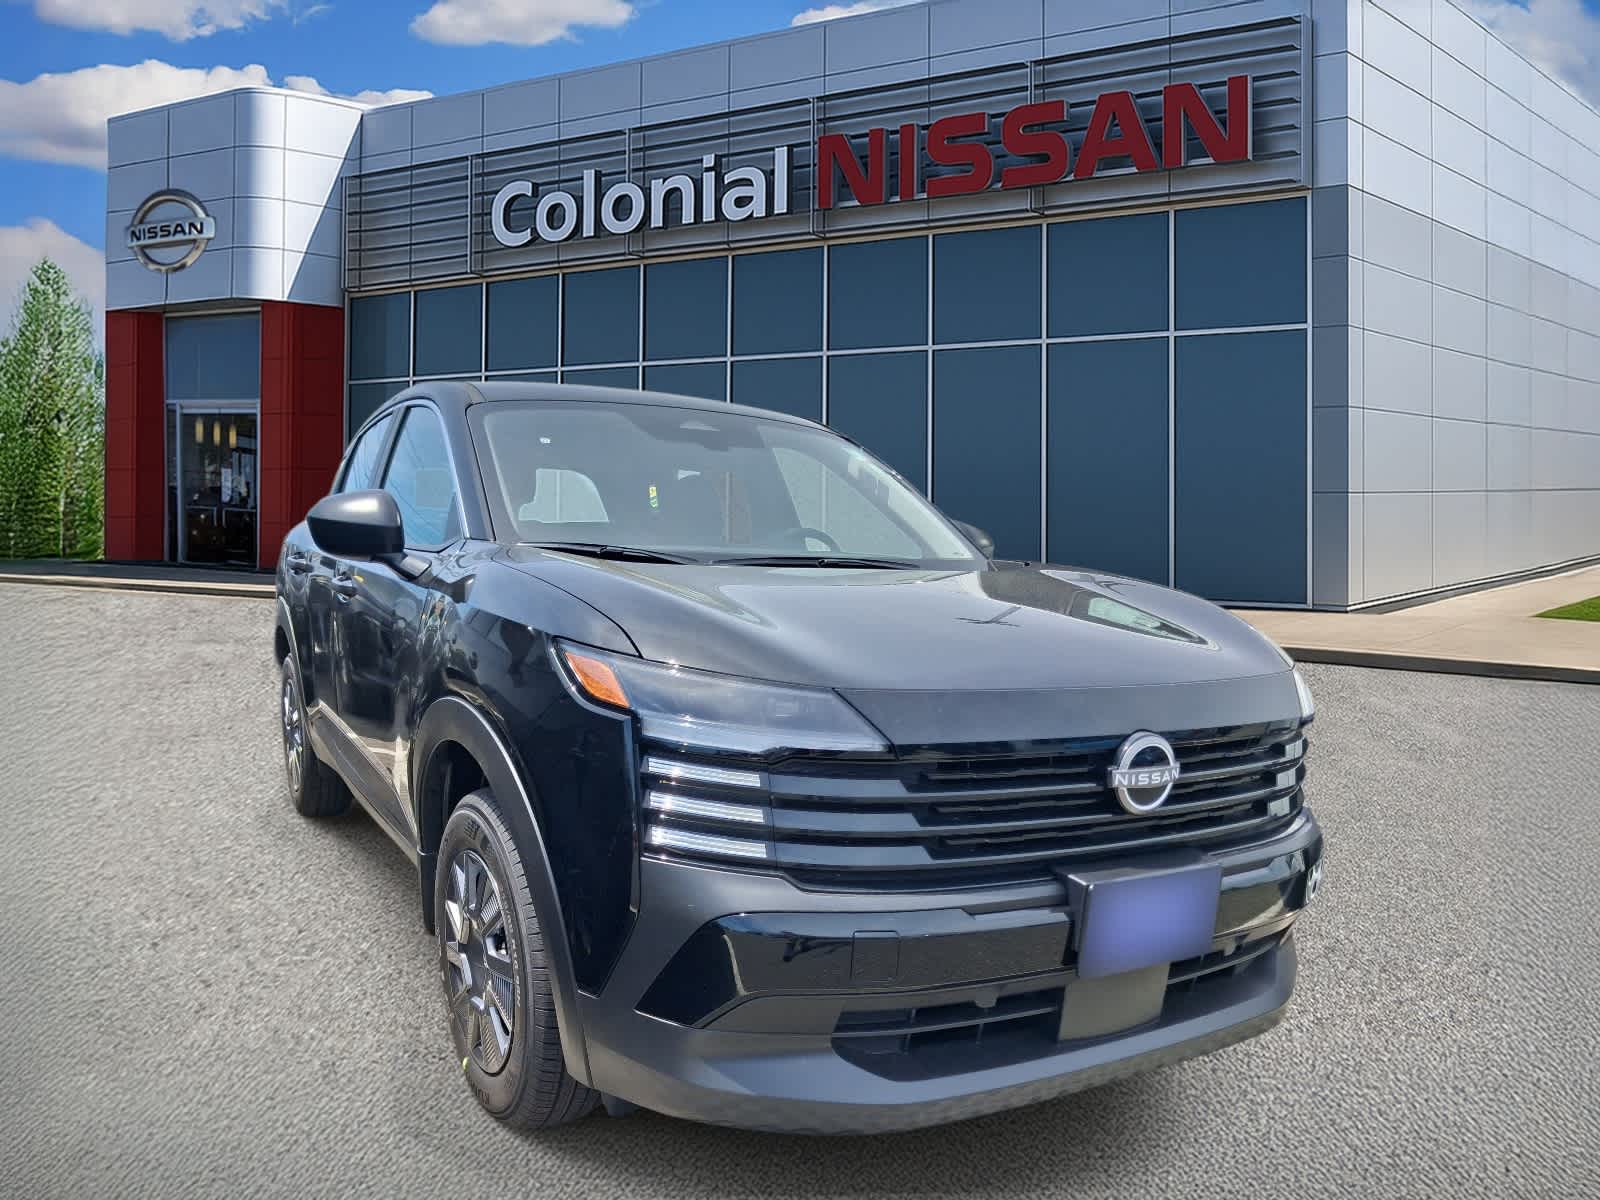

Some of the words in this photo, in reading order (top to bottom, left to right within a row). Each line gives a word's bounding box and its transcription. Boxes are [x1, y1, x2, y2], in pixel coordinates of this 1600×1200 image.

[491, 146, 789, 247] Colonial
[818, 75, 1251, 208] NISSAN
[130, 221, 204, 242] NISSAN
[1114, 767, 1179, 785] NISSAN
